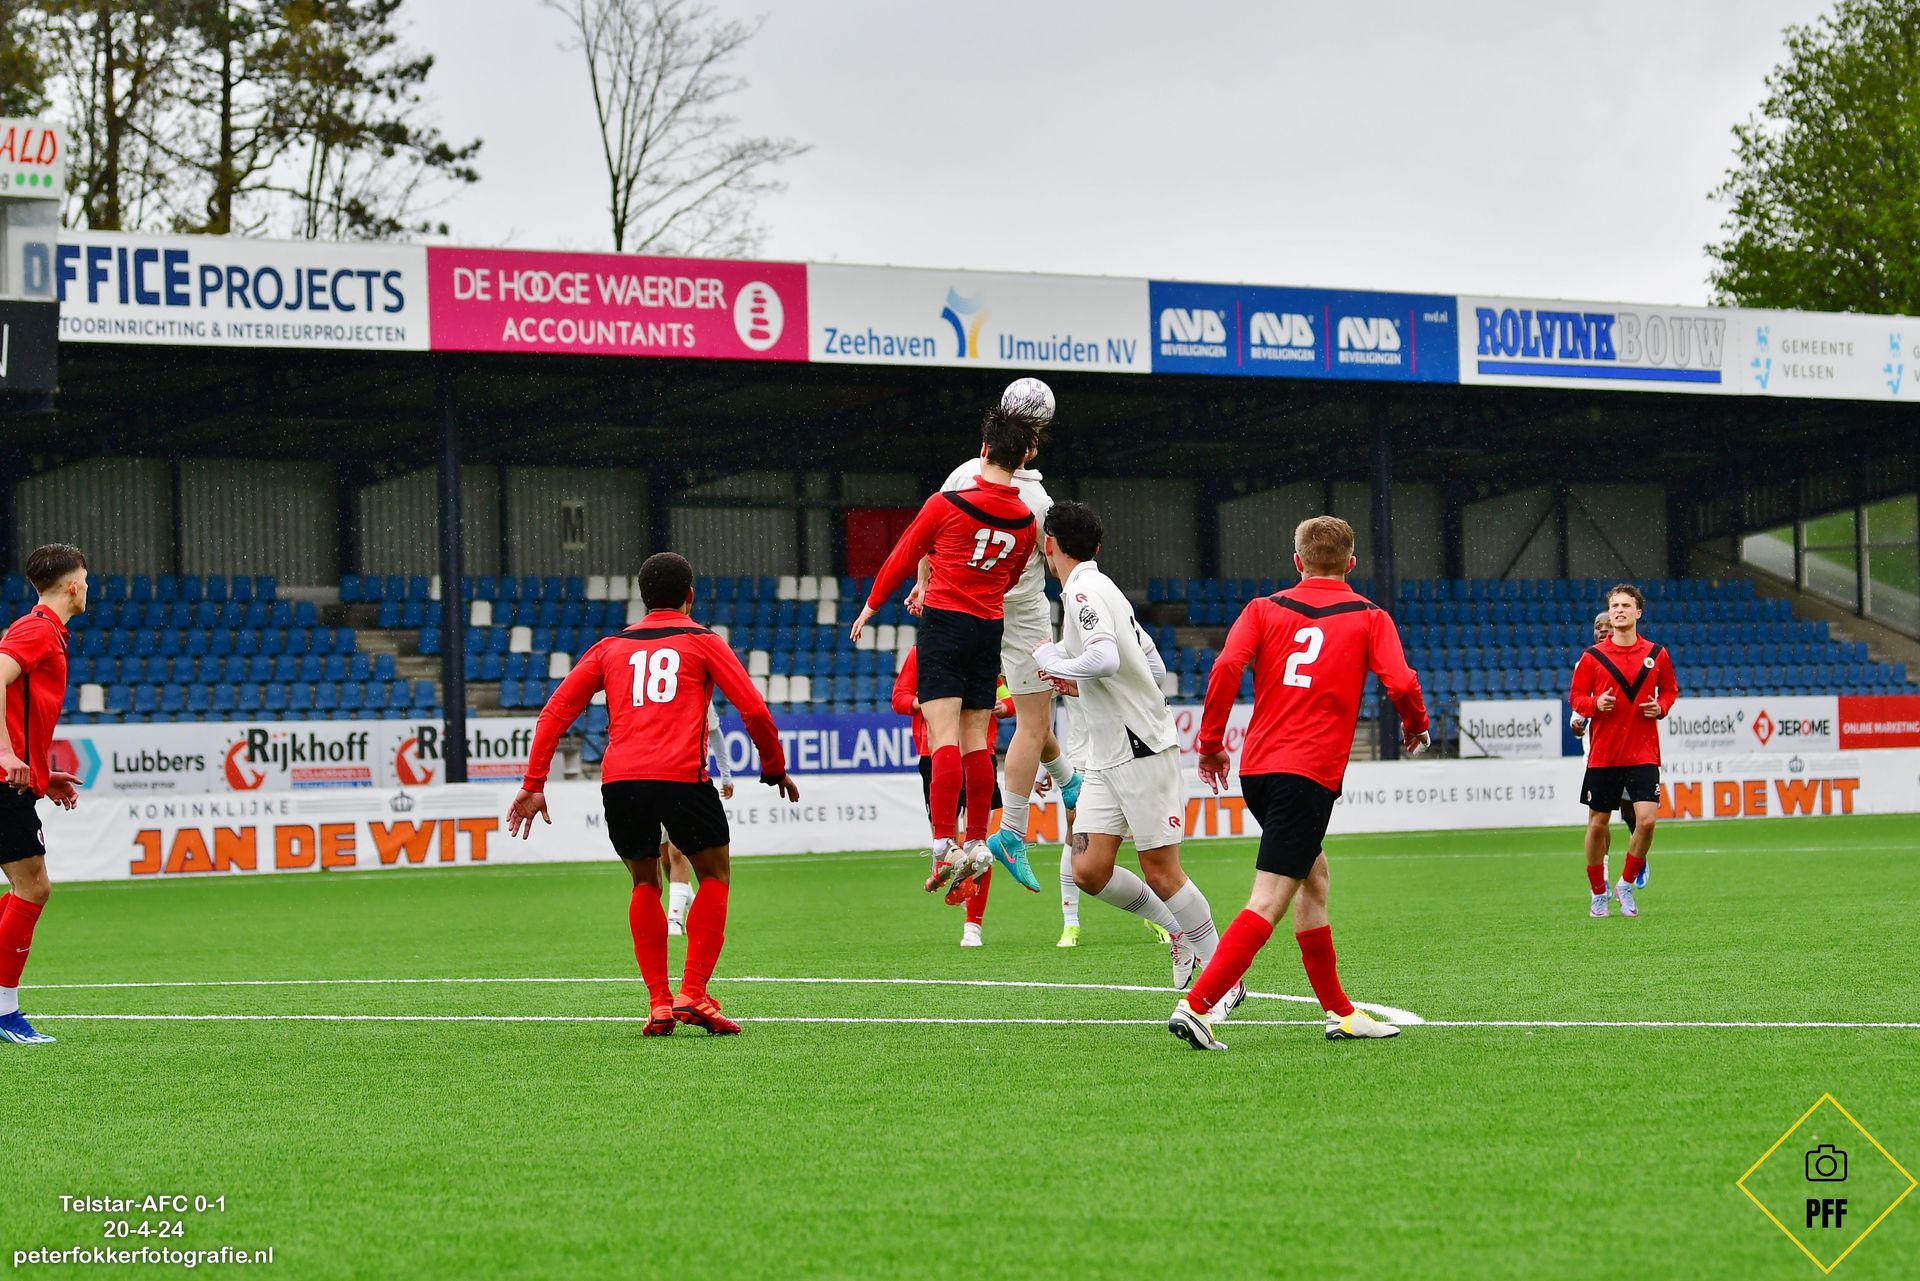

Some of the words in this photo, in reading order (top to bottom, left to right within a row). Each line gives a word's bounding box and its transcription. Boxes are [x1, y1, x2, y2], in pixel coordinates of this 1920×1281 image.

[199, 264, 405, 313] PROJECTS
[454, 267, 491, 300] DE
[499, 269, 590, 304] HOOGE
[597, 274, 727, 310] WAERDER
[212, 322, 222, 338] &
[228, 322, 406, 342] INTERIEURPROJECTEN
[502, 317, 695, 348] ACCOUNTANTS
[1161, 308, 1227, 343] NVD
[1250, 312, 1315, 347] NVD
[1338, 316, 1401, 351] NVD
[824, 328, 936, 358] Zeehaven
[999, 333, 1099, 362] IJmuiden
[1107, 338, 1137, 364] NV
[1782, 339, 1854, 356] GEMEENTE
[1783, 363, 1834, 379] VELSEN
[966, 528, 1017, 571] 17
[1283, 626, 1325, 688] 2
[629, 647, 680, 707] 18
[1469, 717, 1542, 739] bluedesk
[1668, 714, 1736, 736] bluedesk
[1777, 719, 1831, 736] JEROME
[113, 749, 206, 773] Lubbers
[247, 728, 369, 771] Rijkhoff
[129, 800, 290, 819] KONINKLIJKE
[1395, 787, 1458, 804] PEOPLE
[1466, 786, 1513, 801] SINCE
[1521, 785, 1556, 800] 1923
[1713, 779, 1768, 818] DE
[1775, 777, 1861, 815] WIT
[769, 807, 827, 823] SINCE
[837, 806, 879, 821] 1923
[130, 826, 257, 876] JAN
[274, 822, 357, 870] DE
[368, 816, 500, 866] WIT
